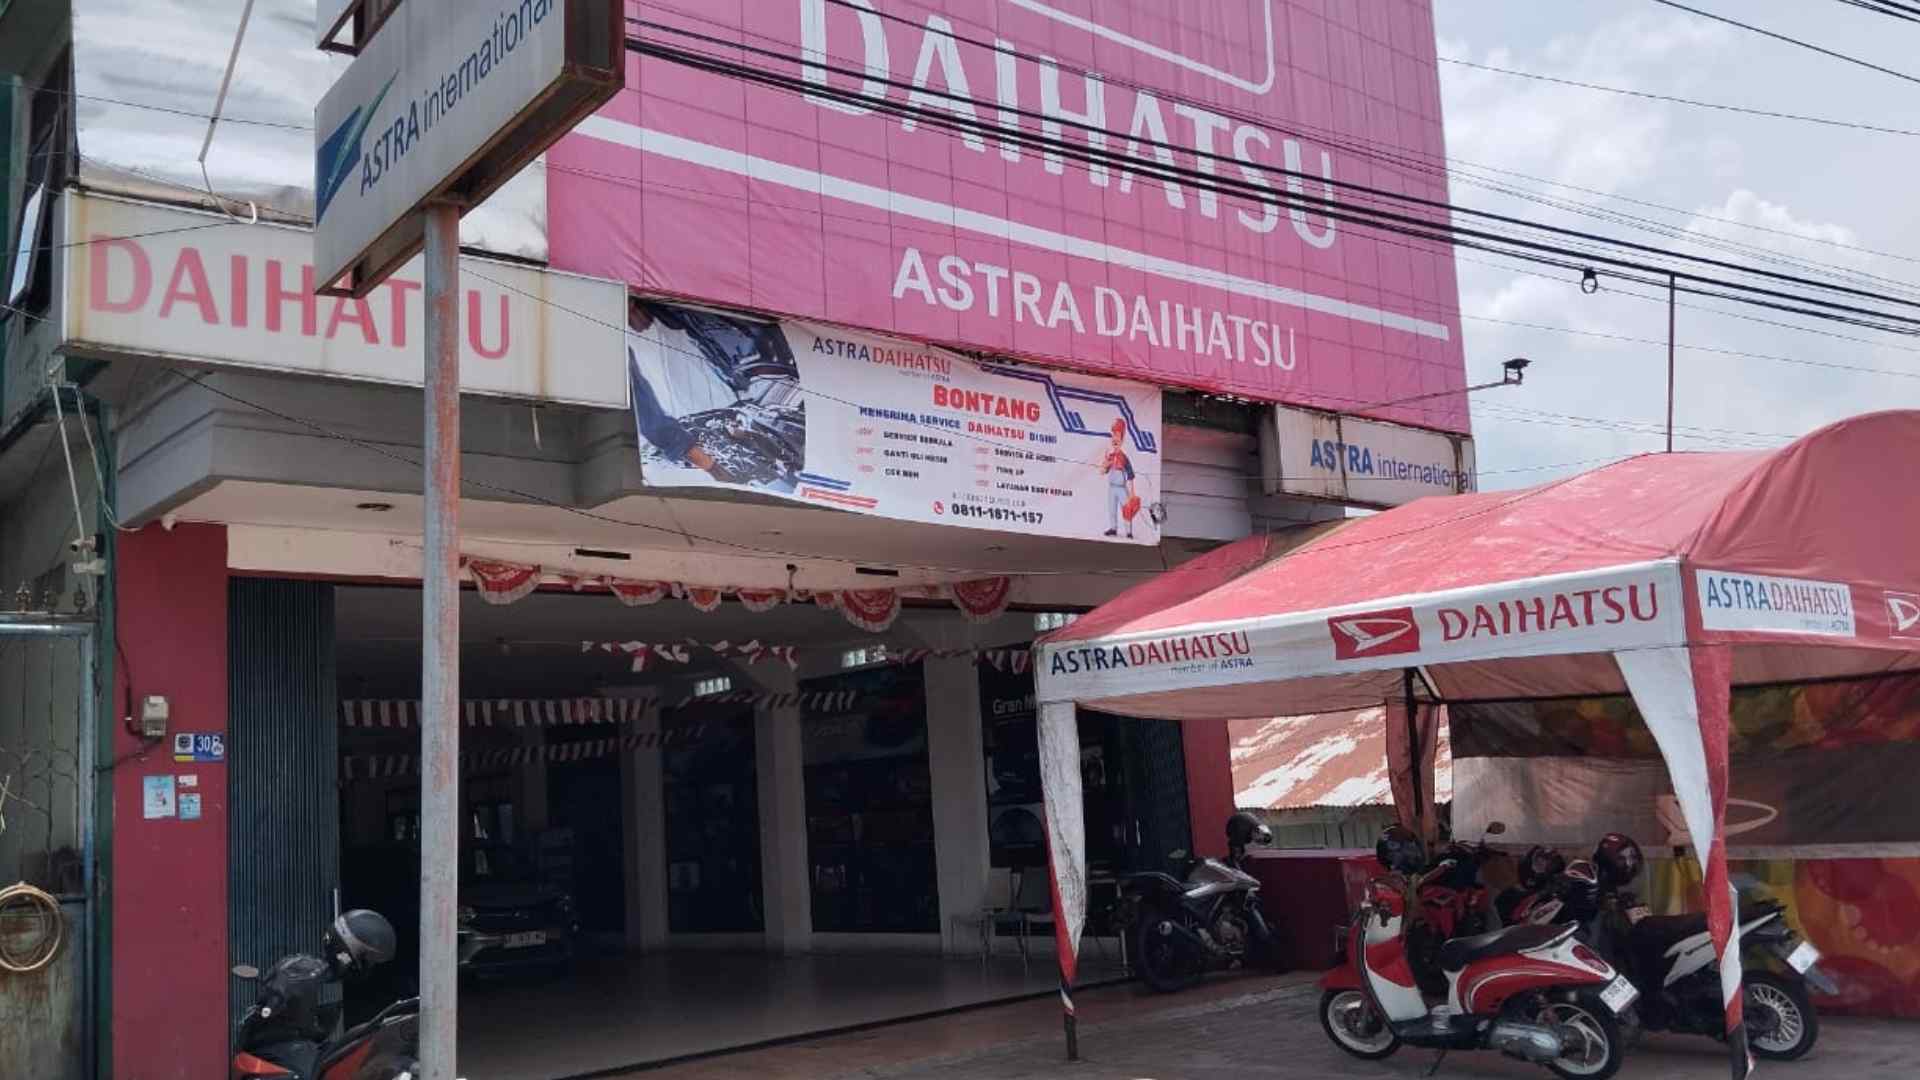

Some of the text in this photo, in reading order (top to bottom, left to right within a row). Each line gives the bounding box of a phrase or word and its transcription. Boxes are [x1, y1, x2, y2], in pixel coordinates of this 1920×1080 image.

[361, 100, 420, 196] ASTRA
[800, 0, 1336, 249] DAIHATSU
[91, 234, 510, 359] DAIHATU
[892, 247, 1296, 371] ASTRA DAIHATSU
[920, 415, 960, 429] SERVICE
[968, 421, 1025, 441] DAIHATSU
[934, 384, 1041, 422] BONTANG
[1311, 438, 1473, 491] ASTRA international
[1437, 582, 1658, 641] DAIHATSU
[1220, 657, 1254, 670] ASTRA
